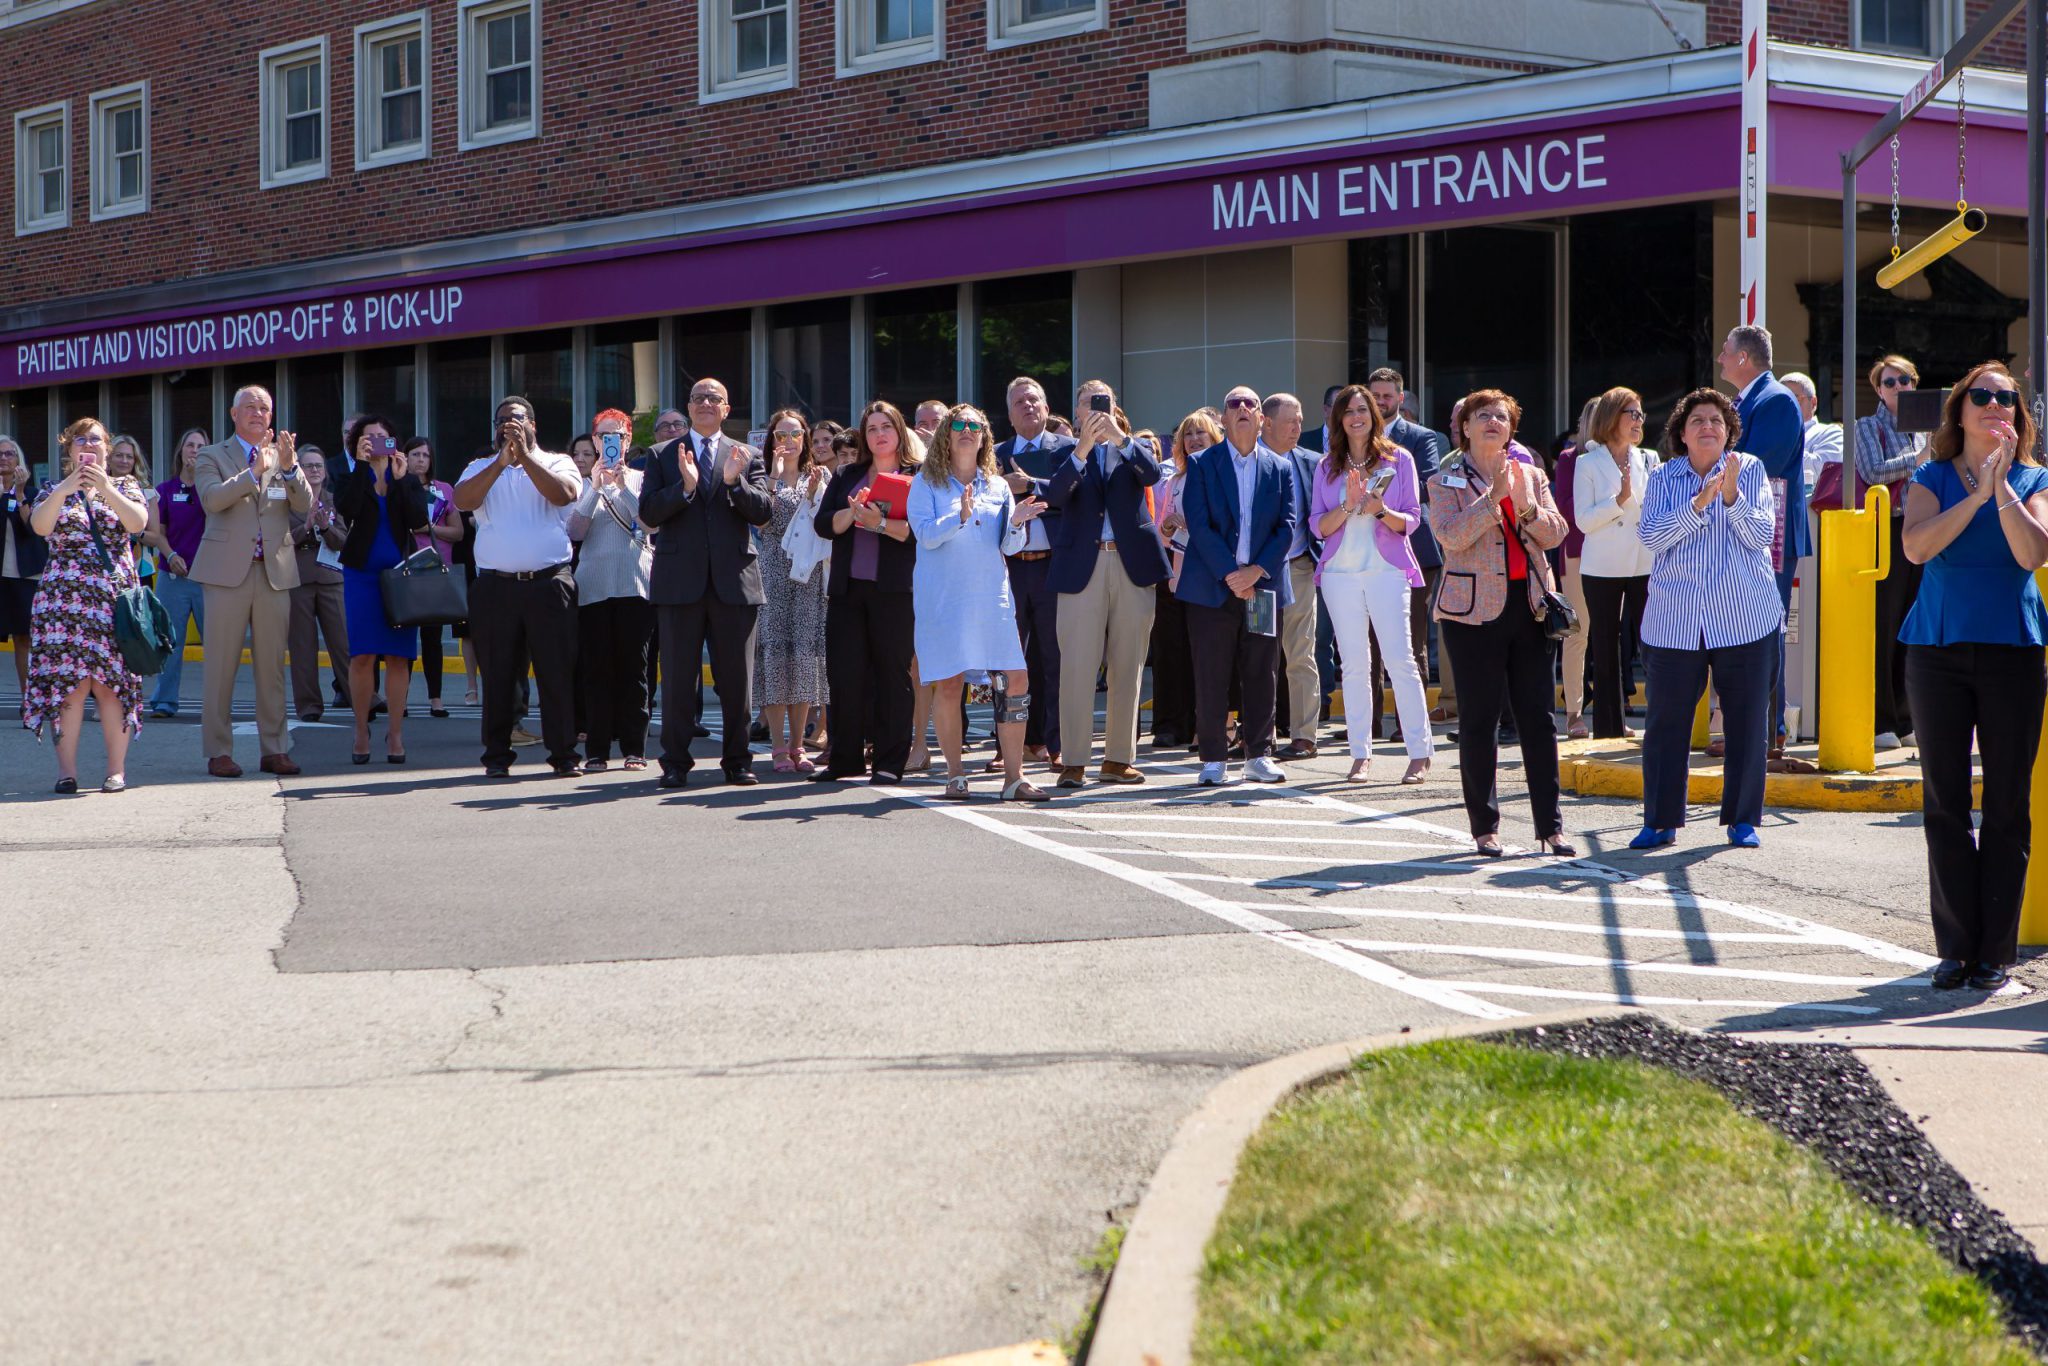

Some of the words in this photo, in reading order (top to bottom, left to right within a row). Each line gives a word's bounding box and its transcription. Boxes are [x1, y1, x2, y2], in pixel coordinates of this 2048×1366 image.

[1213, 172, 1320, 231] MAIN
[1338, 135, 1607, 217] ENTRANCE
[18, 336, 90, 376] PATIENT
[92, 331, 131, 366] AND
[136, 319, 217, 360] VISITOR
[222, 302, 334, 350] DROP-OFF
[342, 299, 357, 335] &
[364, 286, 463, 333] PICK-UP
